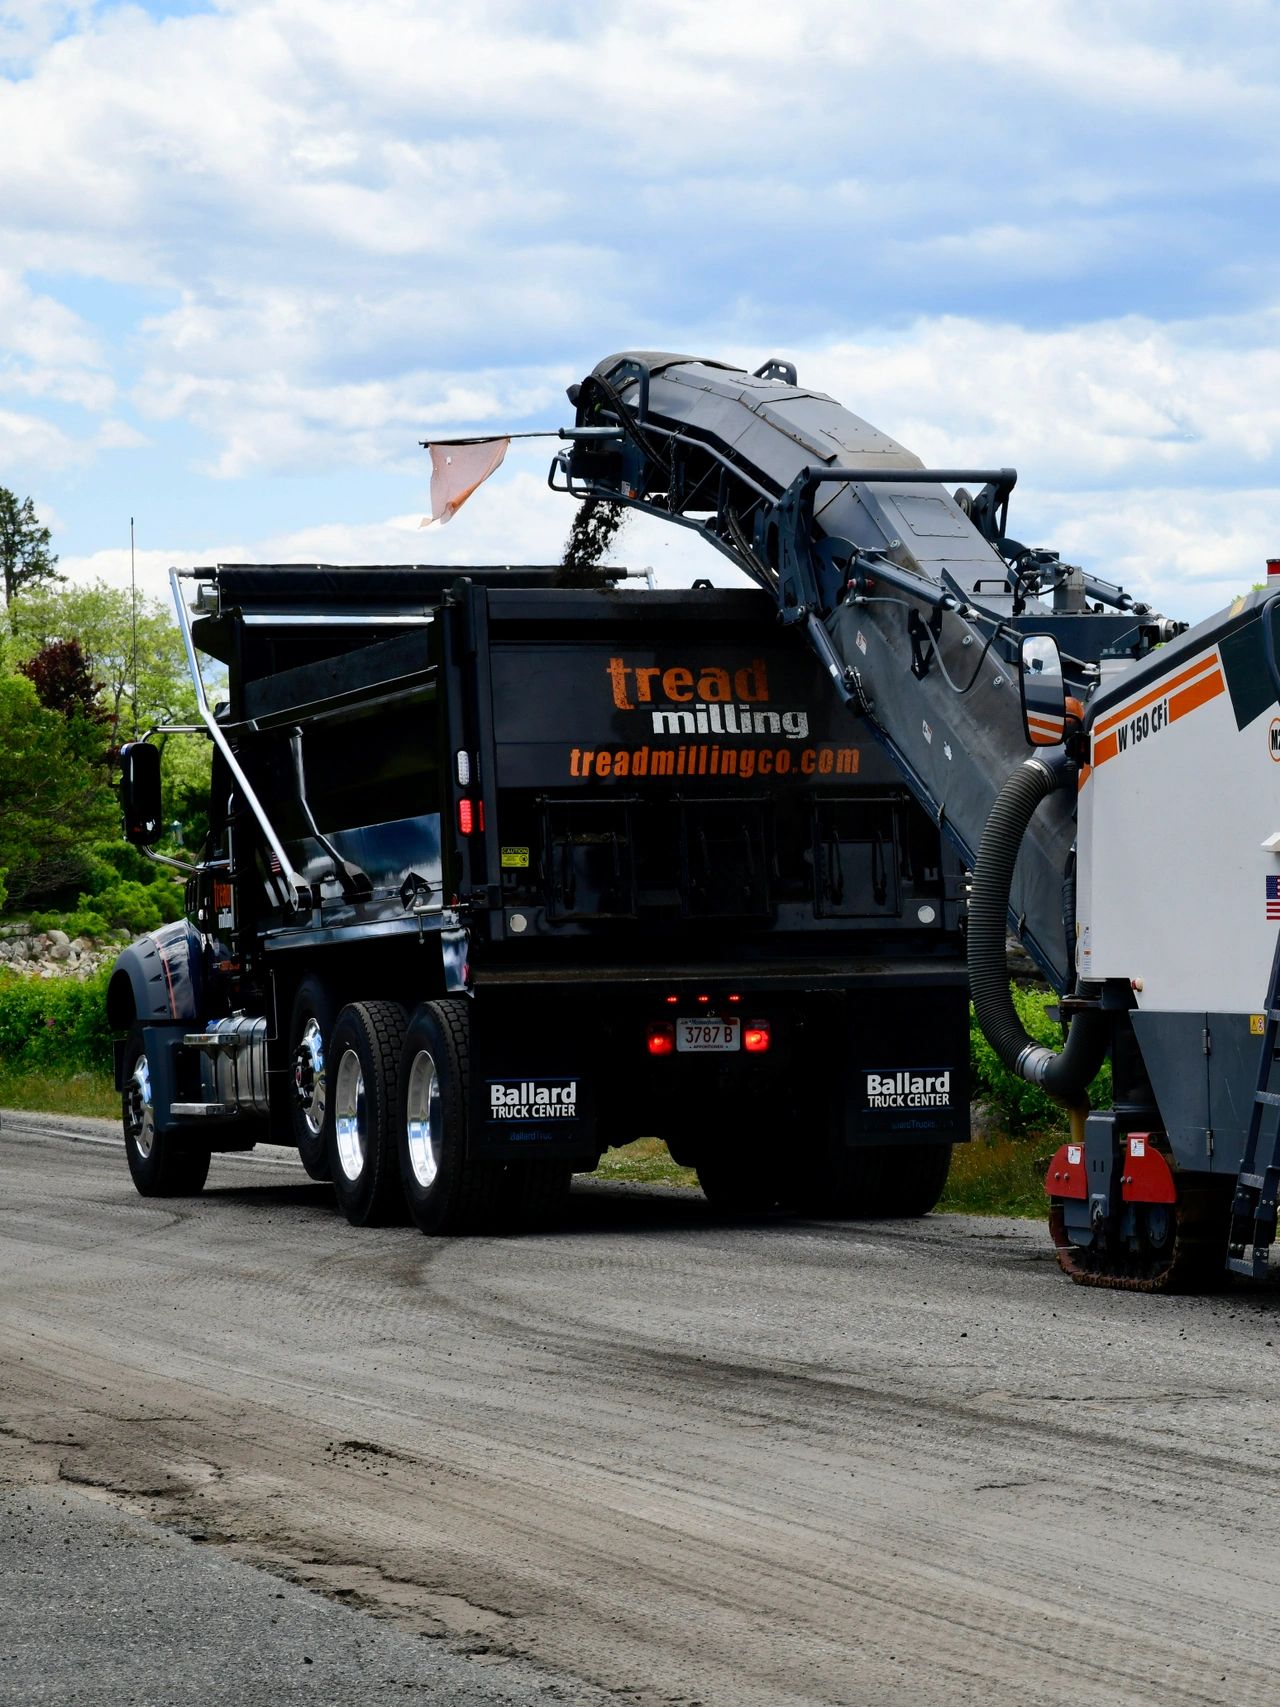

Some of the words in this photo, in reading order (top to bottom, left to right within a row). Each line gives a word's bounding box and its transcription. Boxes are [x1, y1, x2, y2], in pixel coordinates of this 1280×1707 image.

[607, 657, 769, 710] tread
[652, 704, 809, 739] milling
[1117, 723, 1128, 753] W
[1130, 712, 1149, 745] 150
[1151, 698, 1168, 733] CFi
[569, 745, 860, 778] treadmillingco.com
[685, 1026, 720, 1044] 3787
[724, 1026, 733, 1043] B
[490, 1081, 577, 1106] Ballard
[867, 1071, 950, 1095] Ballard
[490, 1105, 530, 1119] TRUCK
[531, 1104, 576, 1118] CENTER
[867, 1095, 905, 1108] TRUCK
[907, 1093, 950, 1107] CENTER
